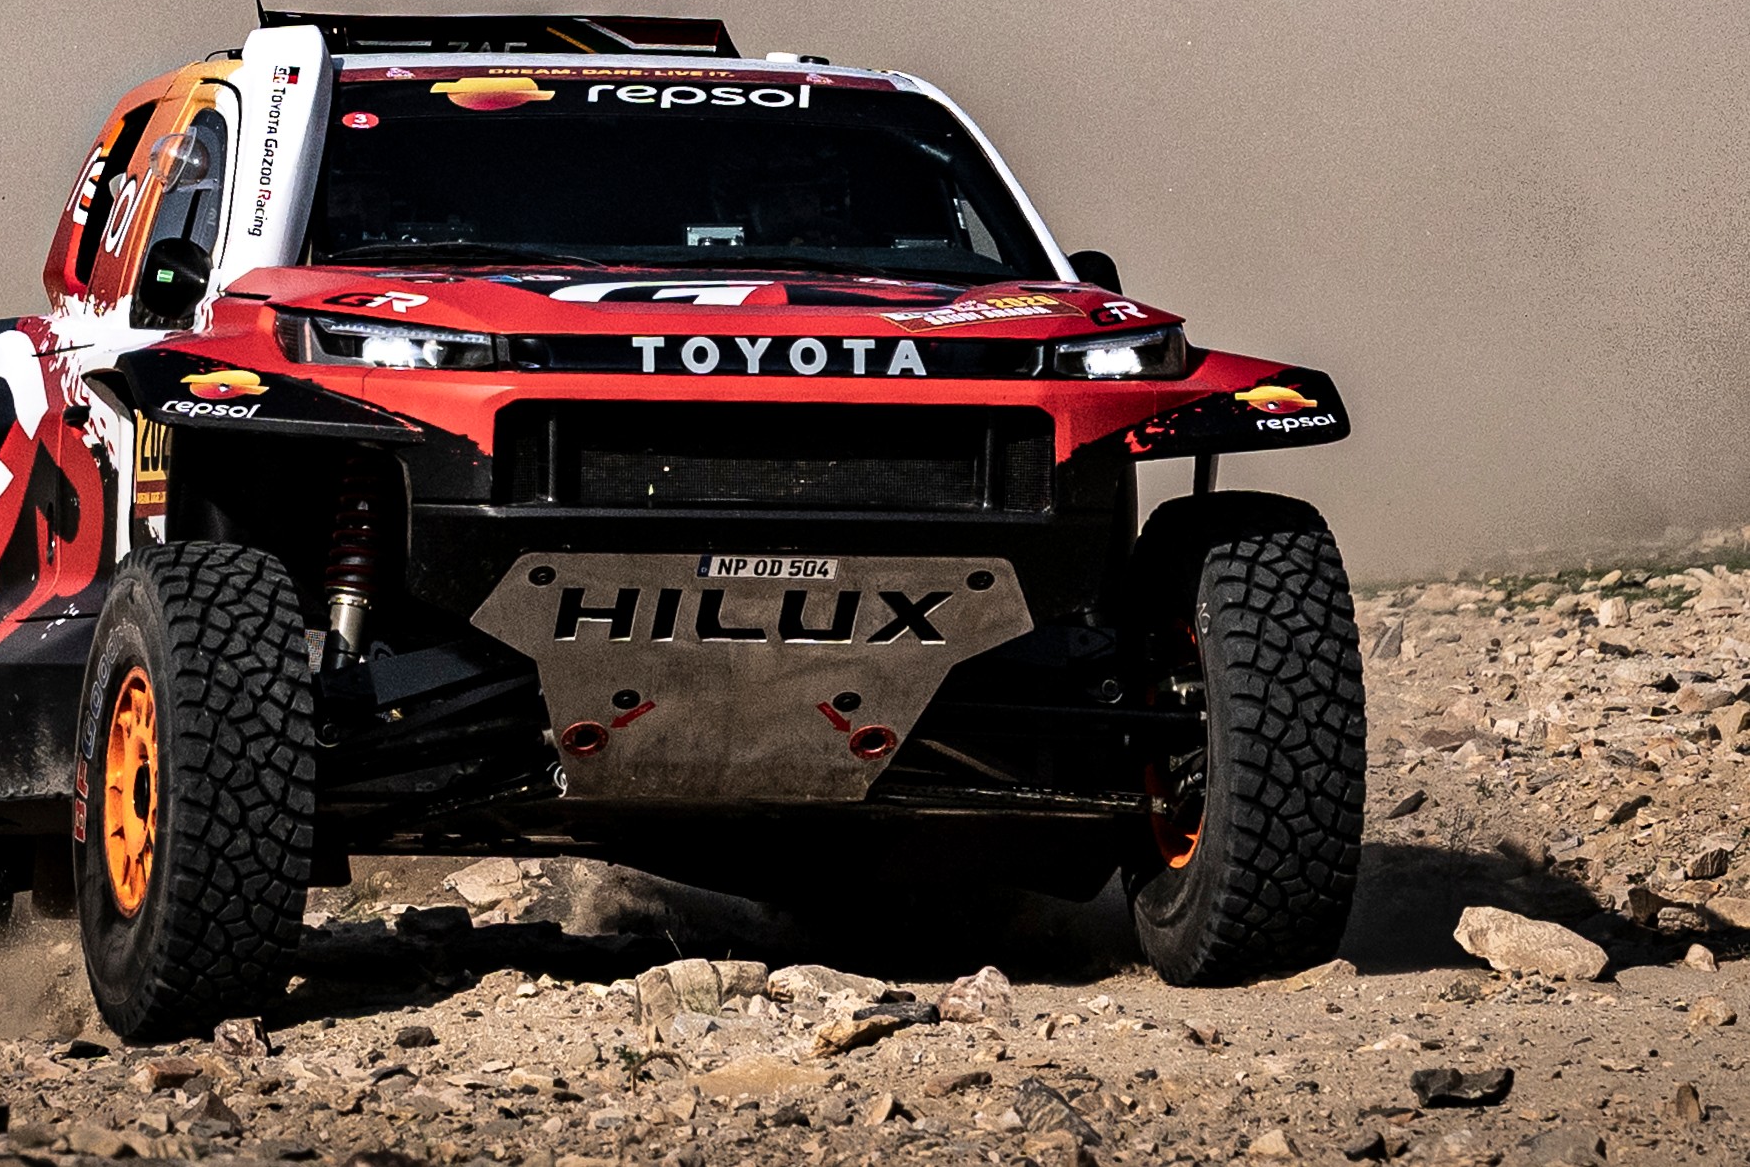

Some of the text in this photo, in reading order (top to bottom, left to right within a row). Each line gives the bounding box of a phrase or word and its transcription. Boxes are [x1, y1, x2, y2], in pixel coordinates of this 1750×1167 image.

[588, 84, 811, 109] repsol
[247, 87, 286, 237] TOYOTA GAZOO Racing
[322, 290, 430, 313] GR
[1089, 301, 1149, 327] GR
[632, 336, 927, 376] TOYOTA
[161, 400, 262, 419] repsol
[1255, 413, 1338, 433] repsol
[717, 558, 748, 576] NP
[754, 559, 783, 577] OD
[788, 559, 830, 578] 504
[553, 587, 954, 645] HILUX
